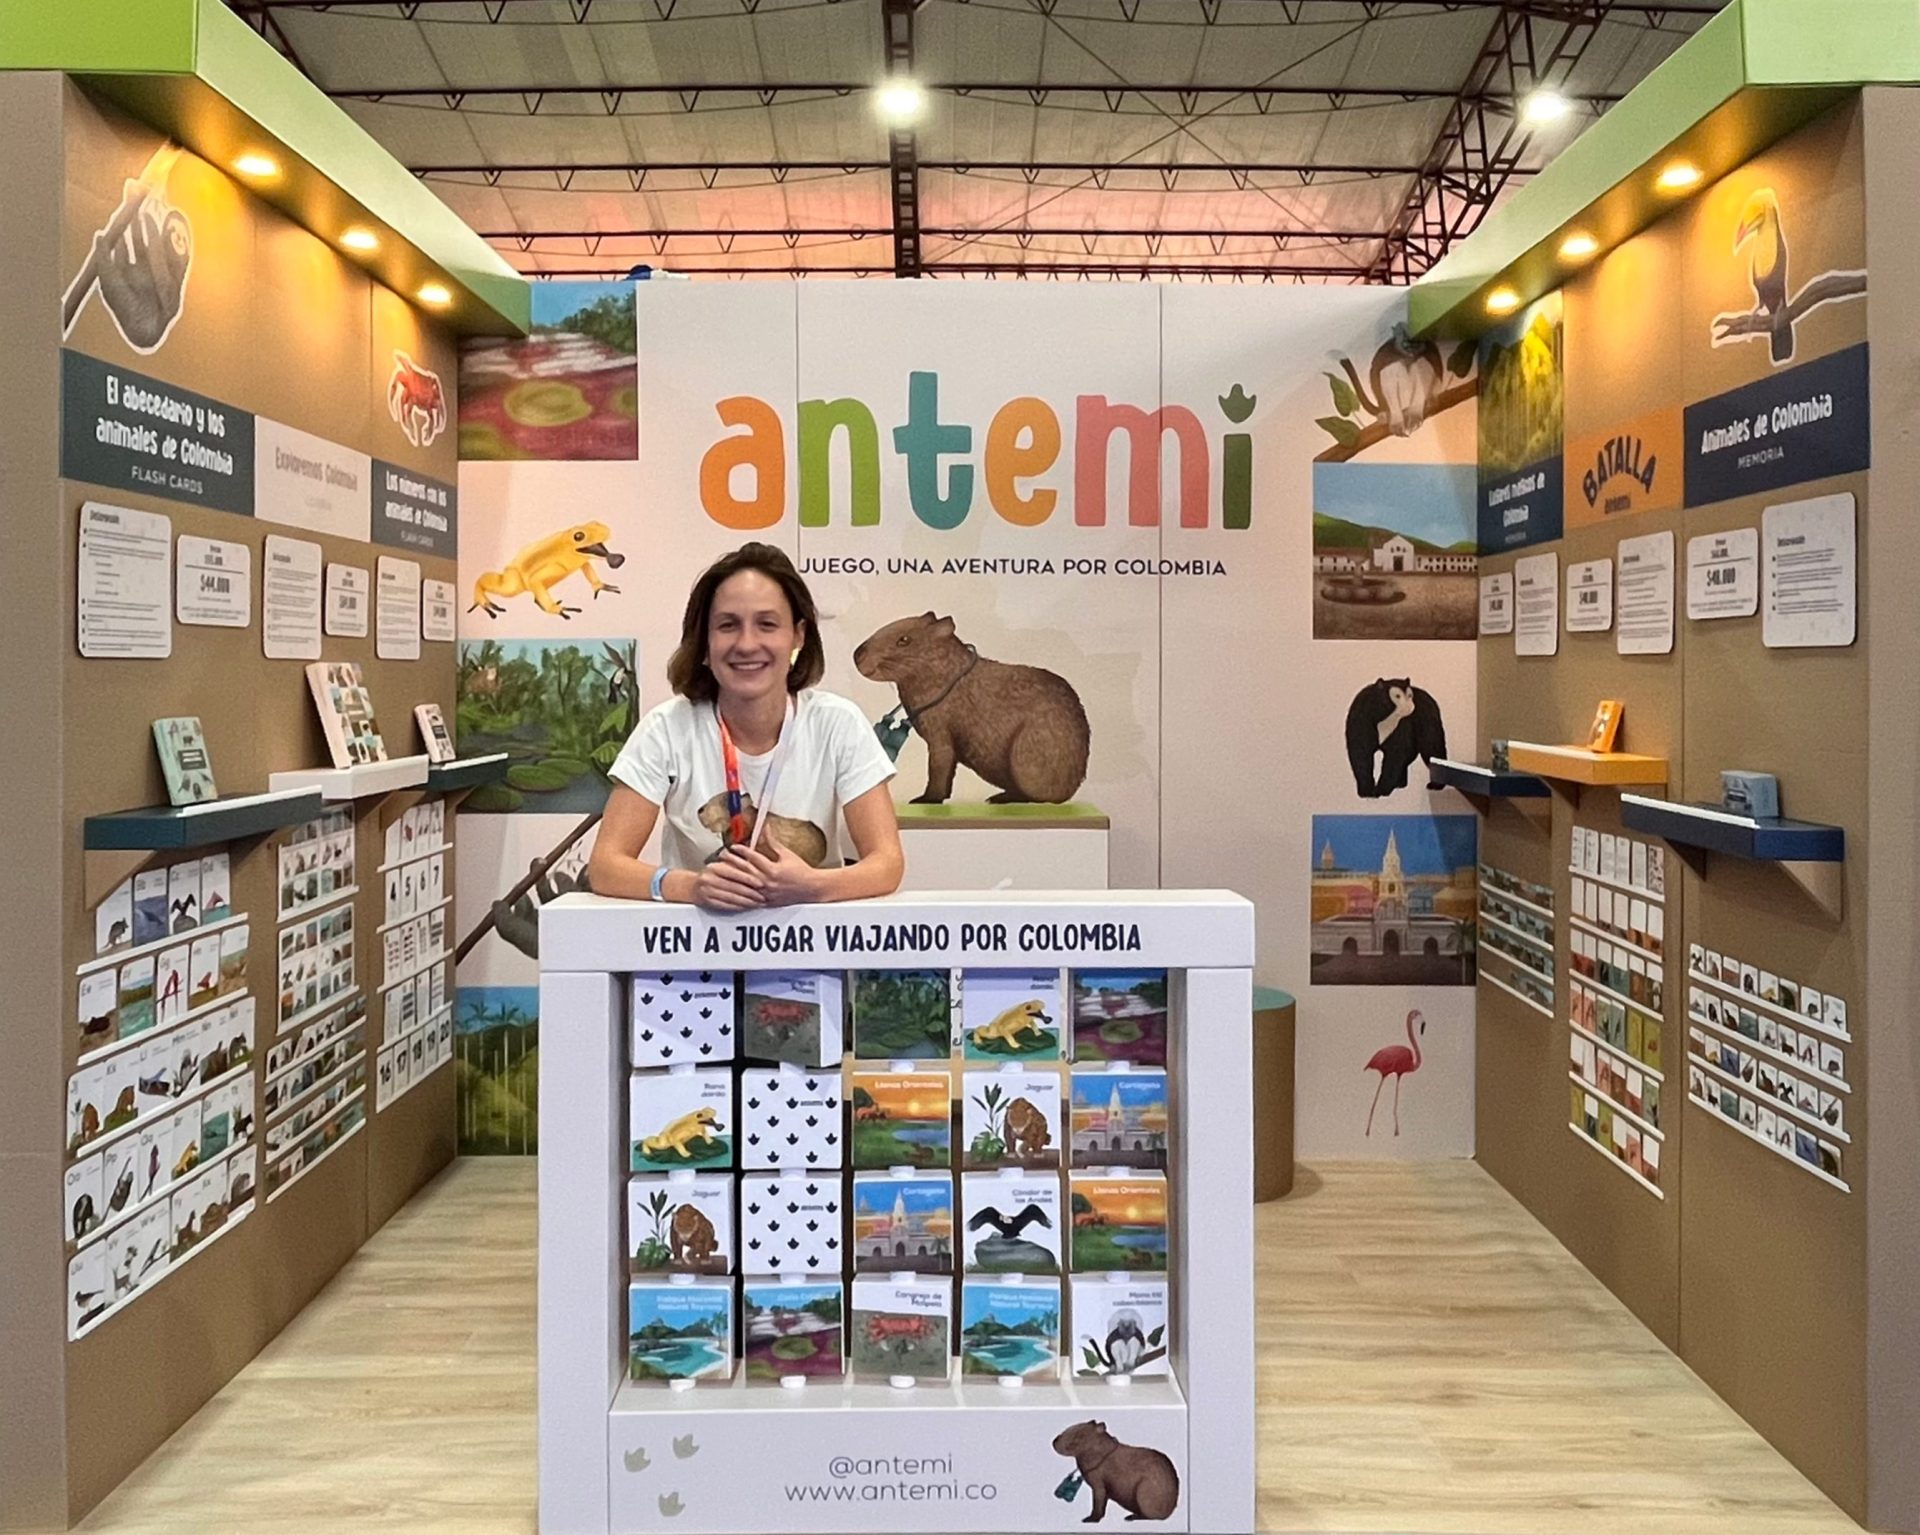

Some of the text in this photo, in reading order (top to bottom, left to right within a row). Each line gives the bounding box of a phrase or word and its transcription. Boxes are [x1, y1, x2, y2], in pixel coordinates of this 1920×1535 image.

[106, 375, 225, 437] El abecedario y los
[1701, 394, 1833, 455] Animales de Colombia
[96, 417, 233, 475] animales de Colombia
[699, 370, 1257, 530] antemi
[1738, 446, 1784, 469] MEMORIA
[131, 466, 203, 494] FLASH CARDS
[1582, 435, 1657, 508] BATALLA
[796, 558, 1227, 577] JUEGO, UNA AVENTURA POR COLOMBIA
[643, 922, 1142, 955] VEN A JUGAR VIAJANDO POR COLOMBIA
[828, 1453, 953, 1479] @antemi
[784, 1479, 998, 1503] www.antemi.co
